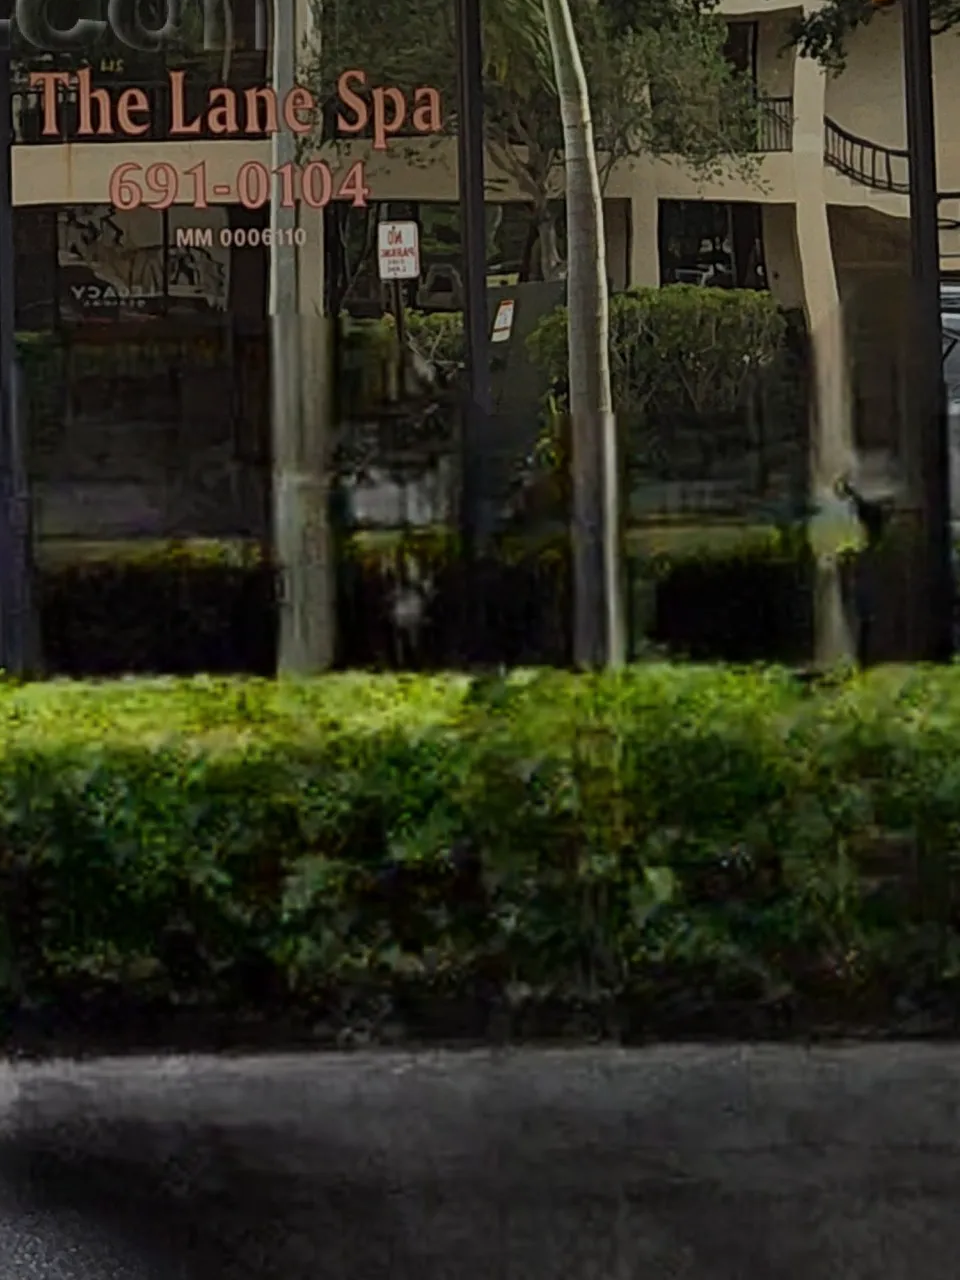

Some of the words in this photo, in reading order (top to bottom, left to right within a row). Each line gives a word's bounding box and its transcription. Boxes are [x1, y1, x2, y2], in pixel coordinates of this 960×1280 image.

[30, 67, 151, 136] The
[168, 69, 315, 136] Lane
[335, 69, 443, 149] Spa
[108, 159, 371, 211] 691-0104
[175, 227, 213, 248] MM
